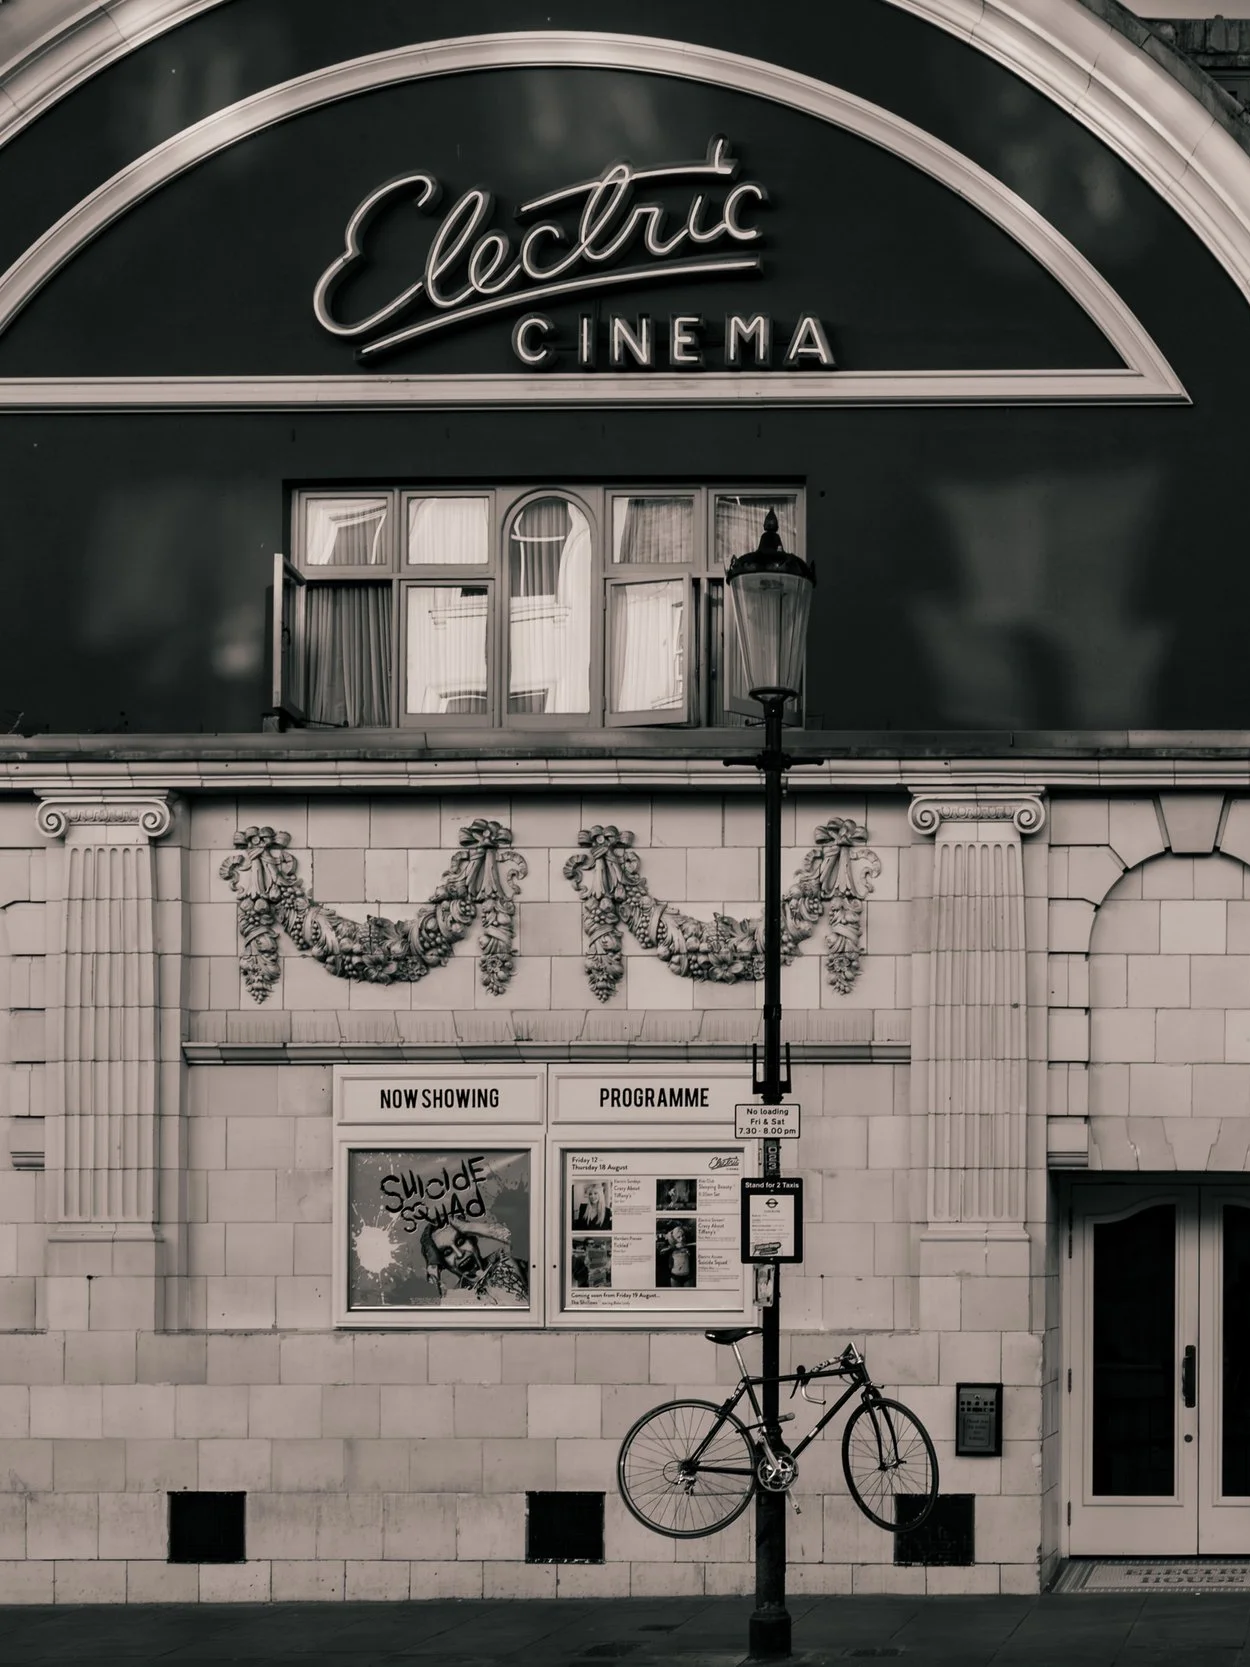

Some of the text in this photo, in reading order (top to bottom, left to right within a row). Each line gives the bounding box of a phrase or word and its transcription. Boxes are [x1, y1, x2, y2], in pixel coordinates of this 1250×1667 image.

[313, 133, 768, 338] Electric
[512, 311, 837, 369] CINEMA
[380, 1088, 500, 1109] NOW SHOWING
[599, 1087, 710, 1108] PROGRAMME
[760, 1108, 789, 1116] loading
[571, 1156, 590, 1164] Friday
[607, 1164, 628, 1172] August
